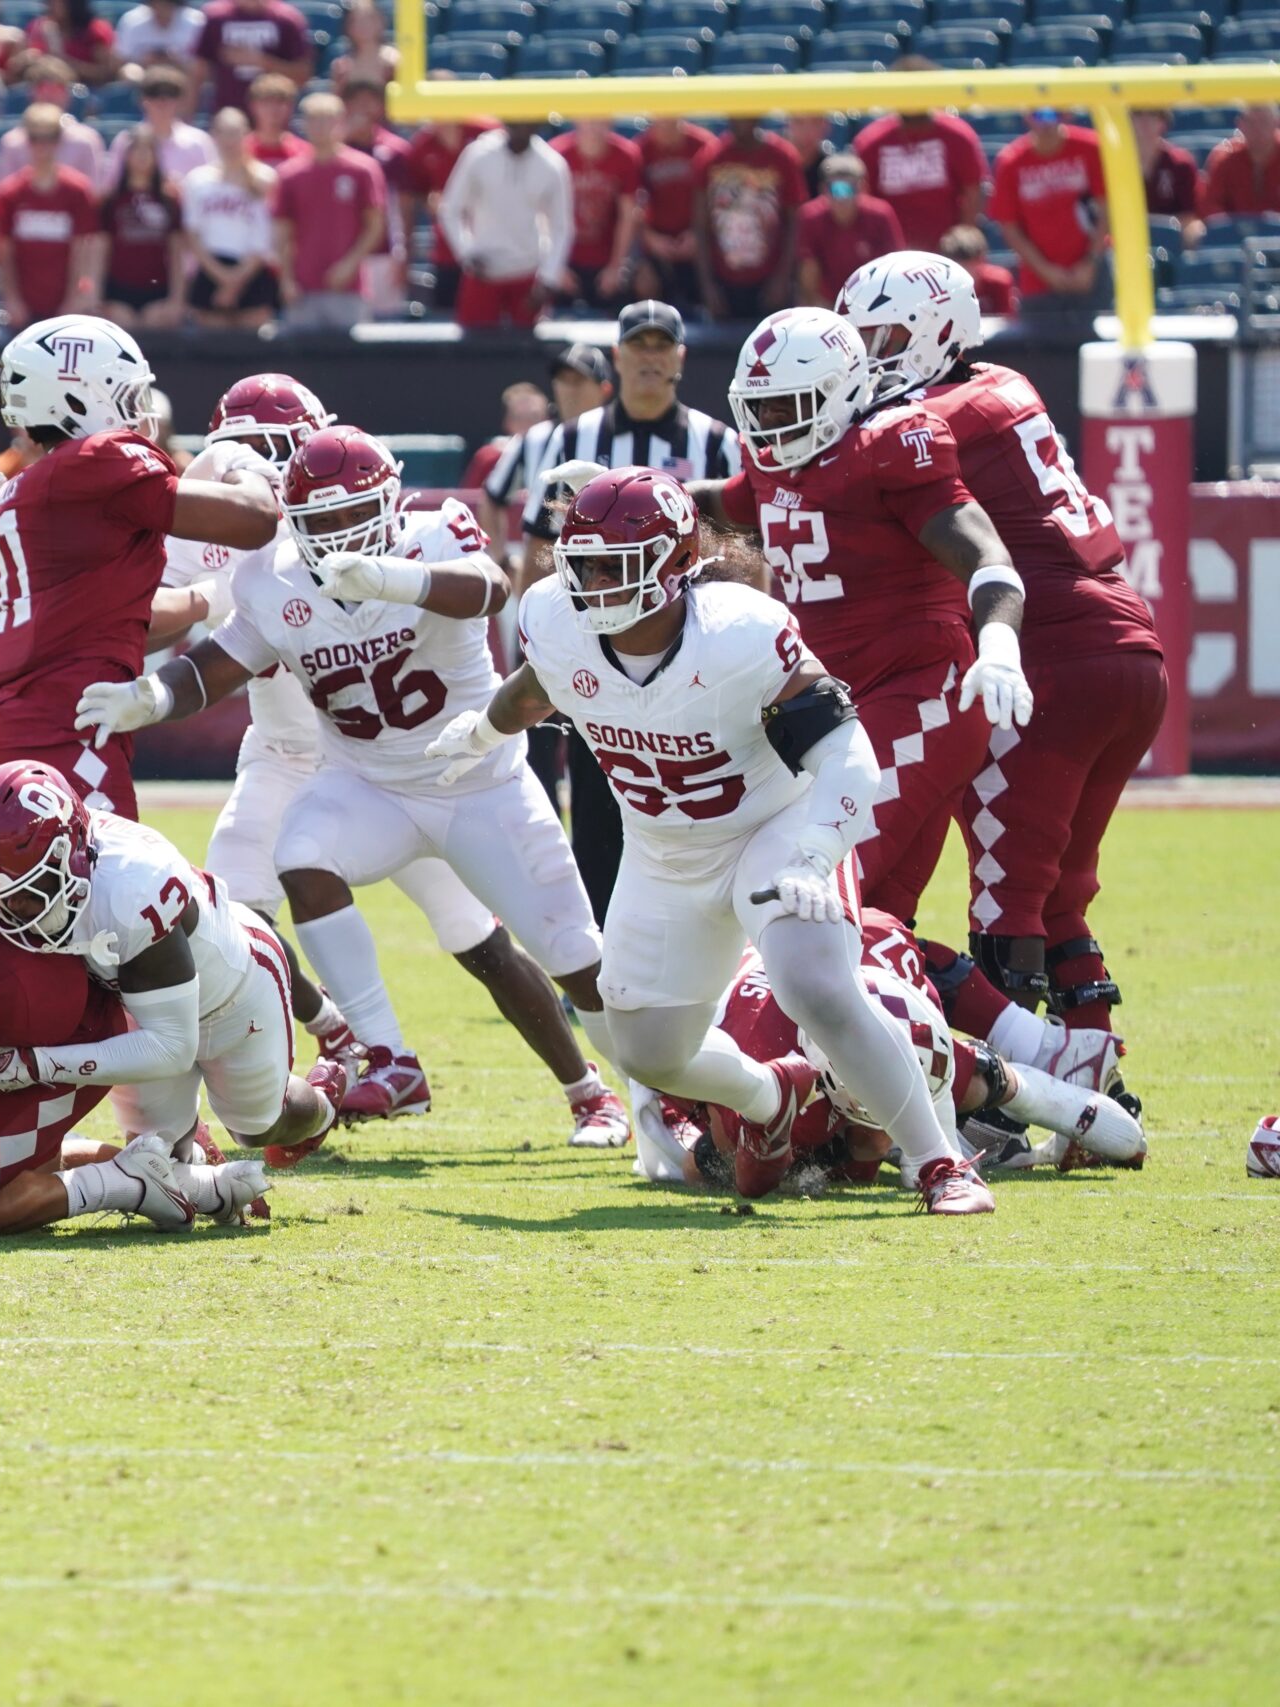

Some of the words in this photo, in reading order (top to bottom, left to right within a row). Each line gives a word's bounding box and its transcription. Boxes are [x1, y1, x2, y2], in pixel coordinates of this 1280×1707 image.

[52, 337, 94, 382] T
[746, 378, 770, 387] OWLS
[901, 427, 935, 468] T
[771, 486, 803, 510] TEMPLE
[760, 503, 845, 603] 52
[283, 600, 312, 627] SEC
[572, 670, 599, 697] SEC
[585, 721, 716, 757] SOONERS
[593, 747, 747, 820] 65
[139, 876, 190, 943] 13
